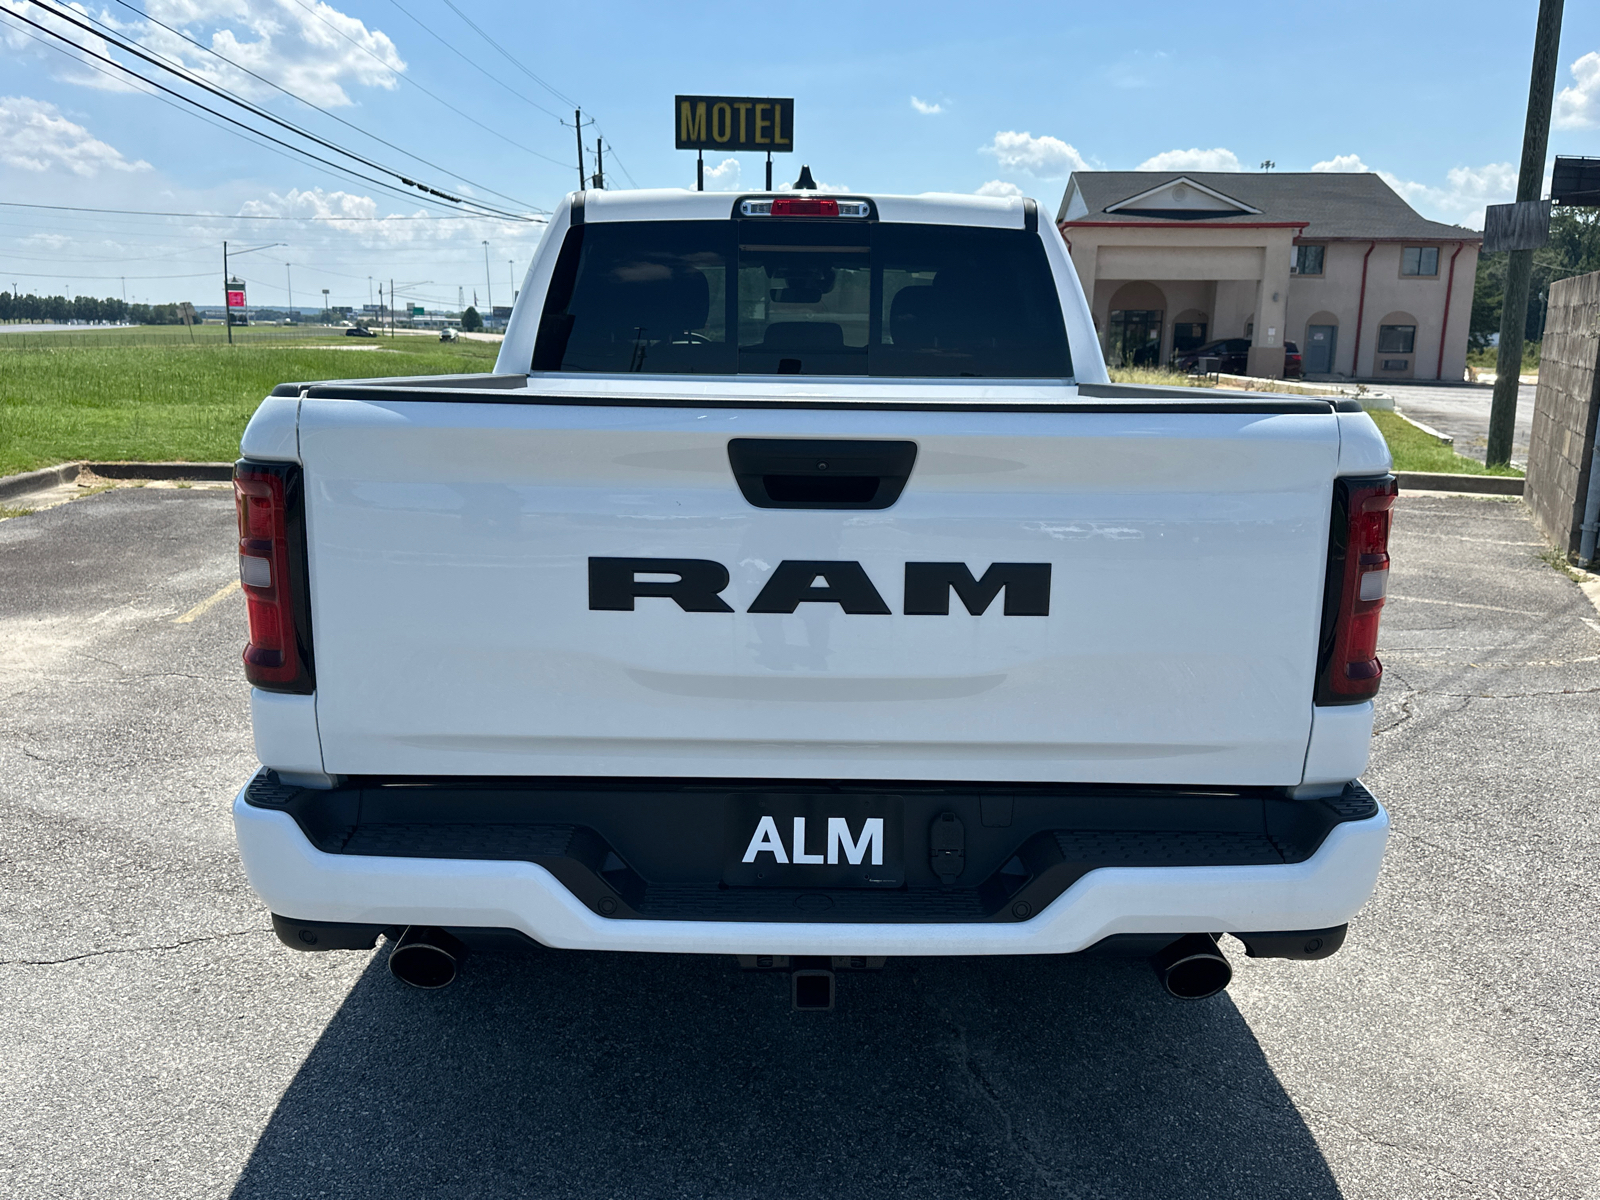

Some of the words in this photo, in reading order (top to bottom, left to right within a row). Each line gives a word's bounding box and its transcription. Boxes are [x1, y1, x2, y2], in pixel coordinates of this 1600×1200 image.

[680, 101, 790, 144] MOTEL
[588, 557, 1052, 616] RAM
[741, 816, 884, 866] ALM
